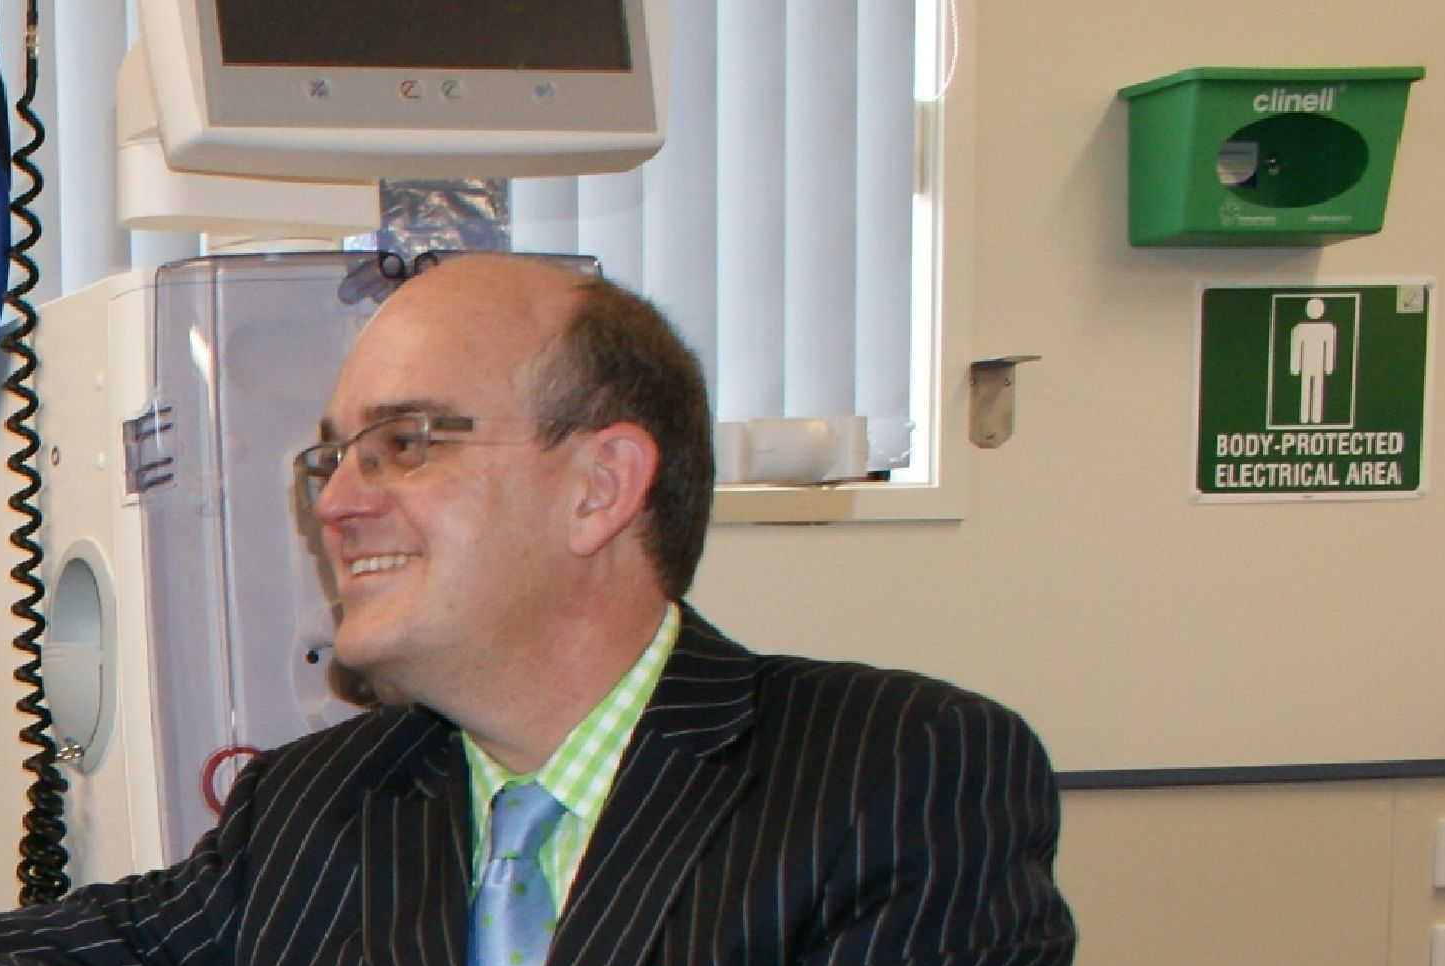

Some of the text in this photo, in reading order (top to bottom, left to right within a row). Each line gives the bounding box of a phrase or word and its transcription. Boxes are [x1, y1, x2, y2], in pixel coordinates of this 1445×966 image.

[1253, 87, 1335, 112] clinell
[1216, 432, 1405, 457] BODY-PROTECTED
[1214, 461, 1402, 488] ELECTRICAL AREA
